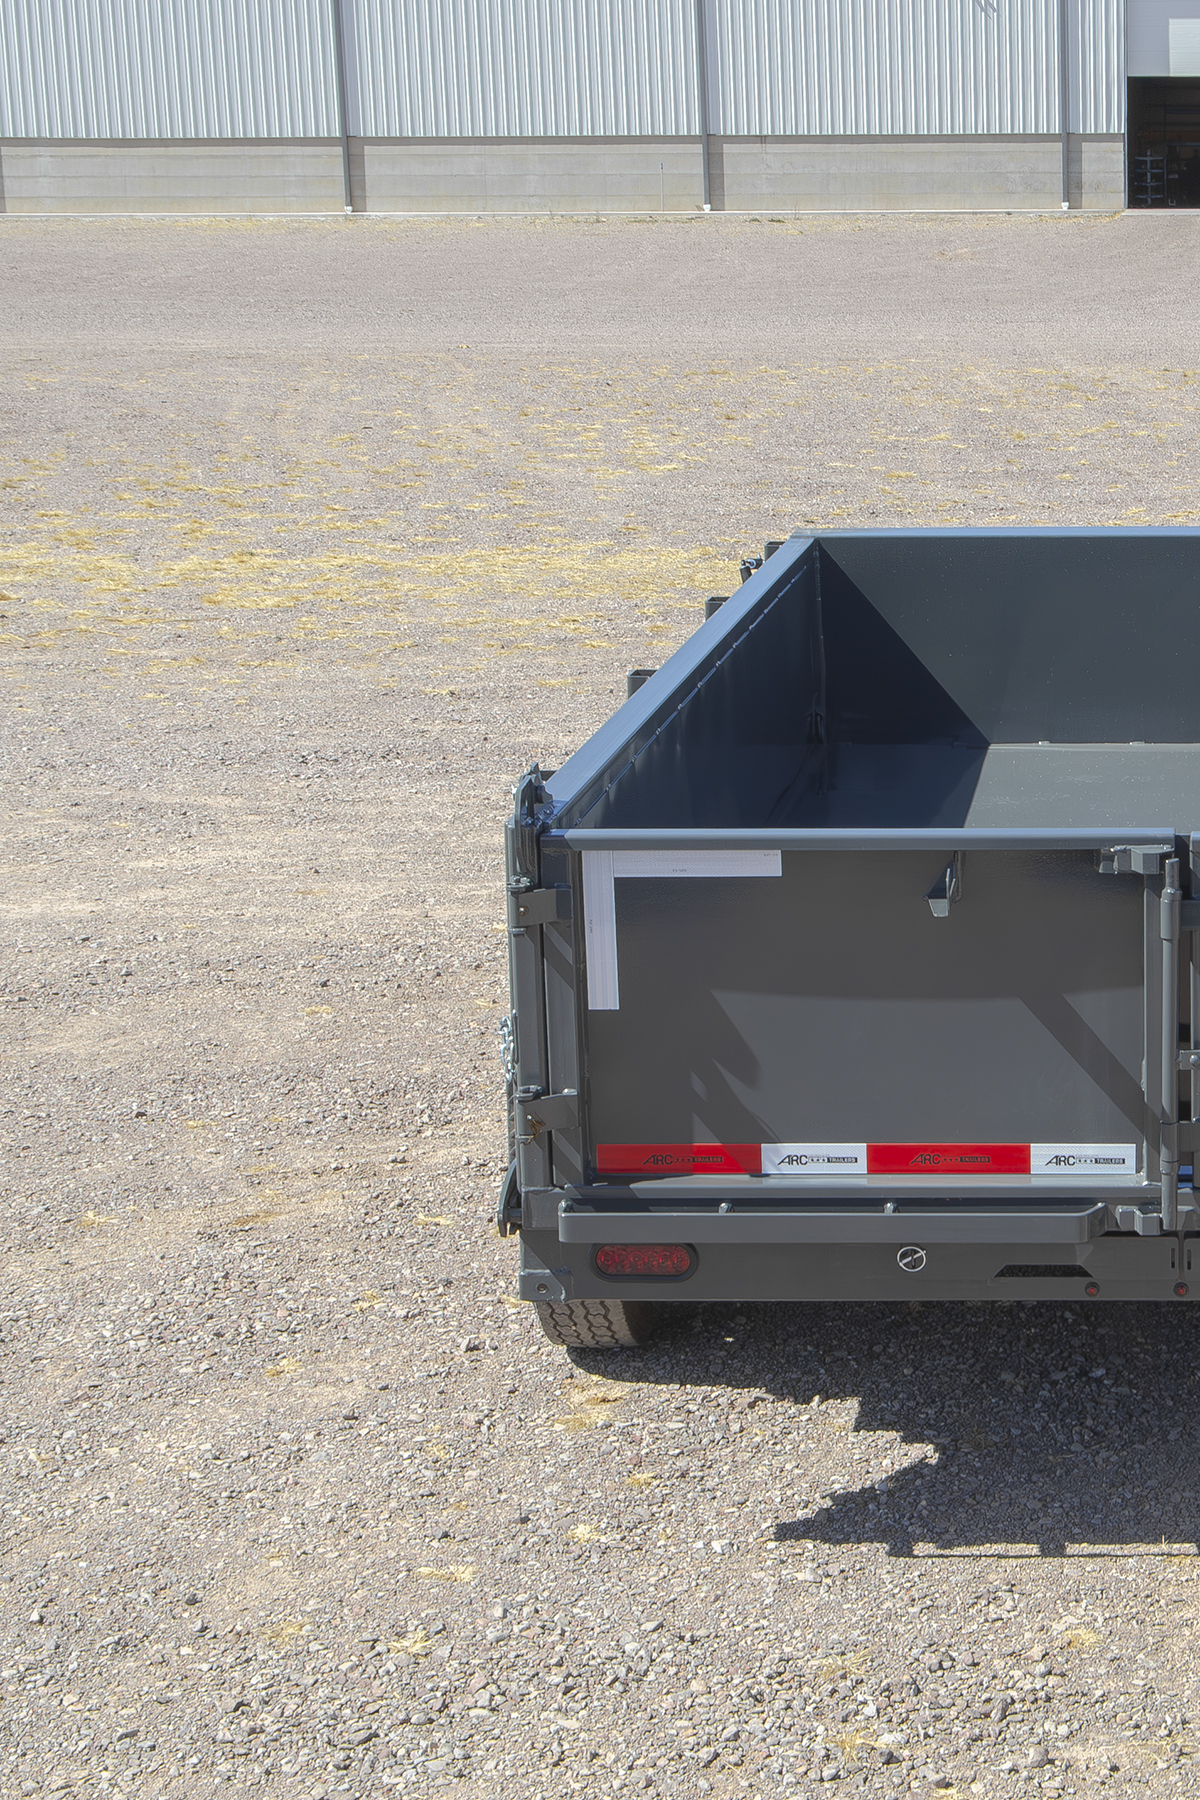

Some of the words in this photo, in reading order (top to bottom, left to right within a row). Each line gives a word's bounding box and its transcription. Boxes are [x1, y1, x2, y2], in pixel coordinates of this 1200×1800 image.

[642, 1154, 674, 1165] ARC
[777, 1154, 808, 1166] ARC
[910, 1153, 941, 1165] ARC
[1045, 1155, 1076, 1167] ARC
